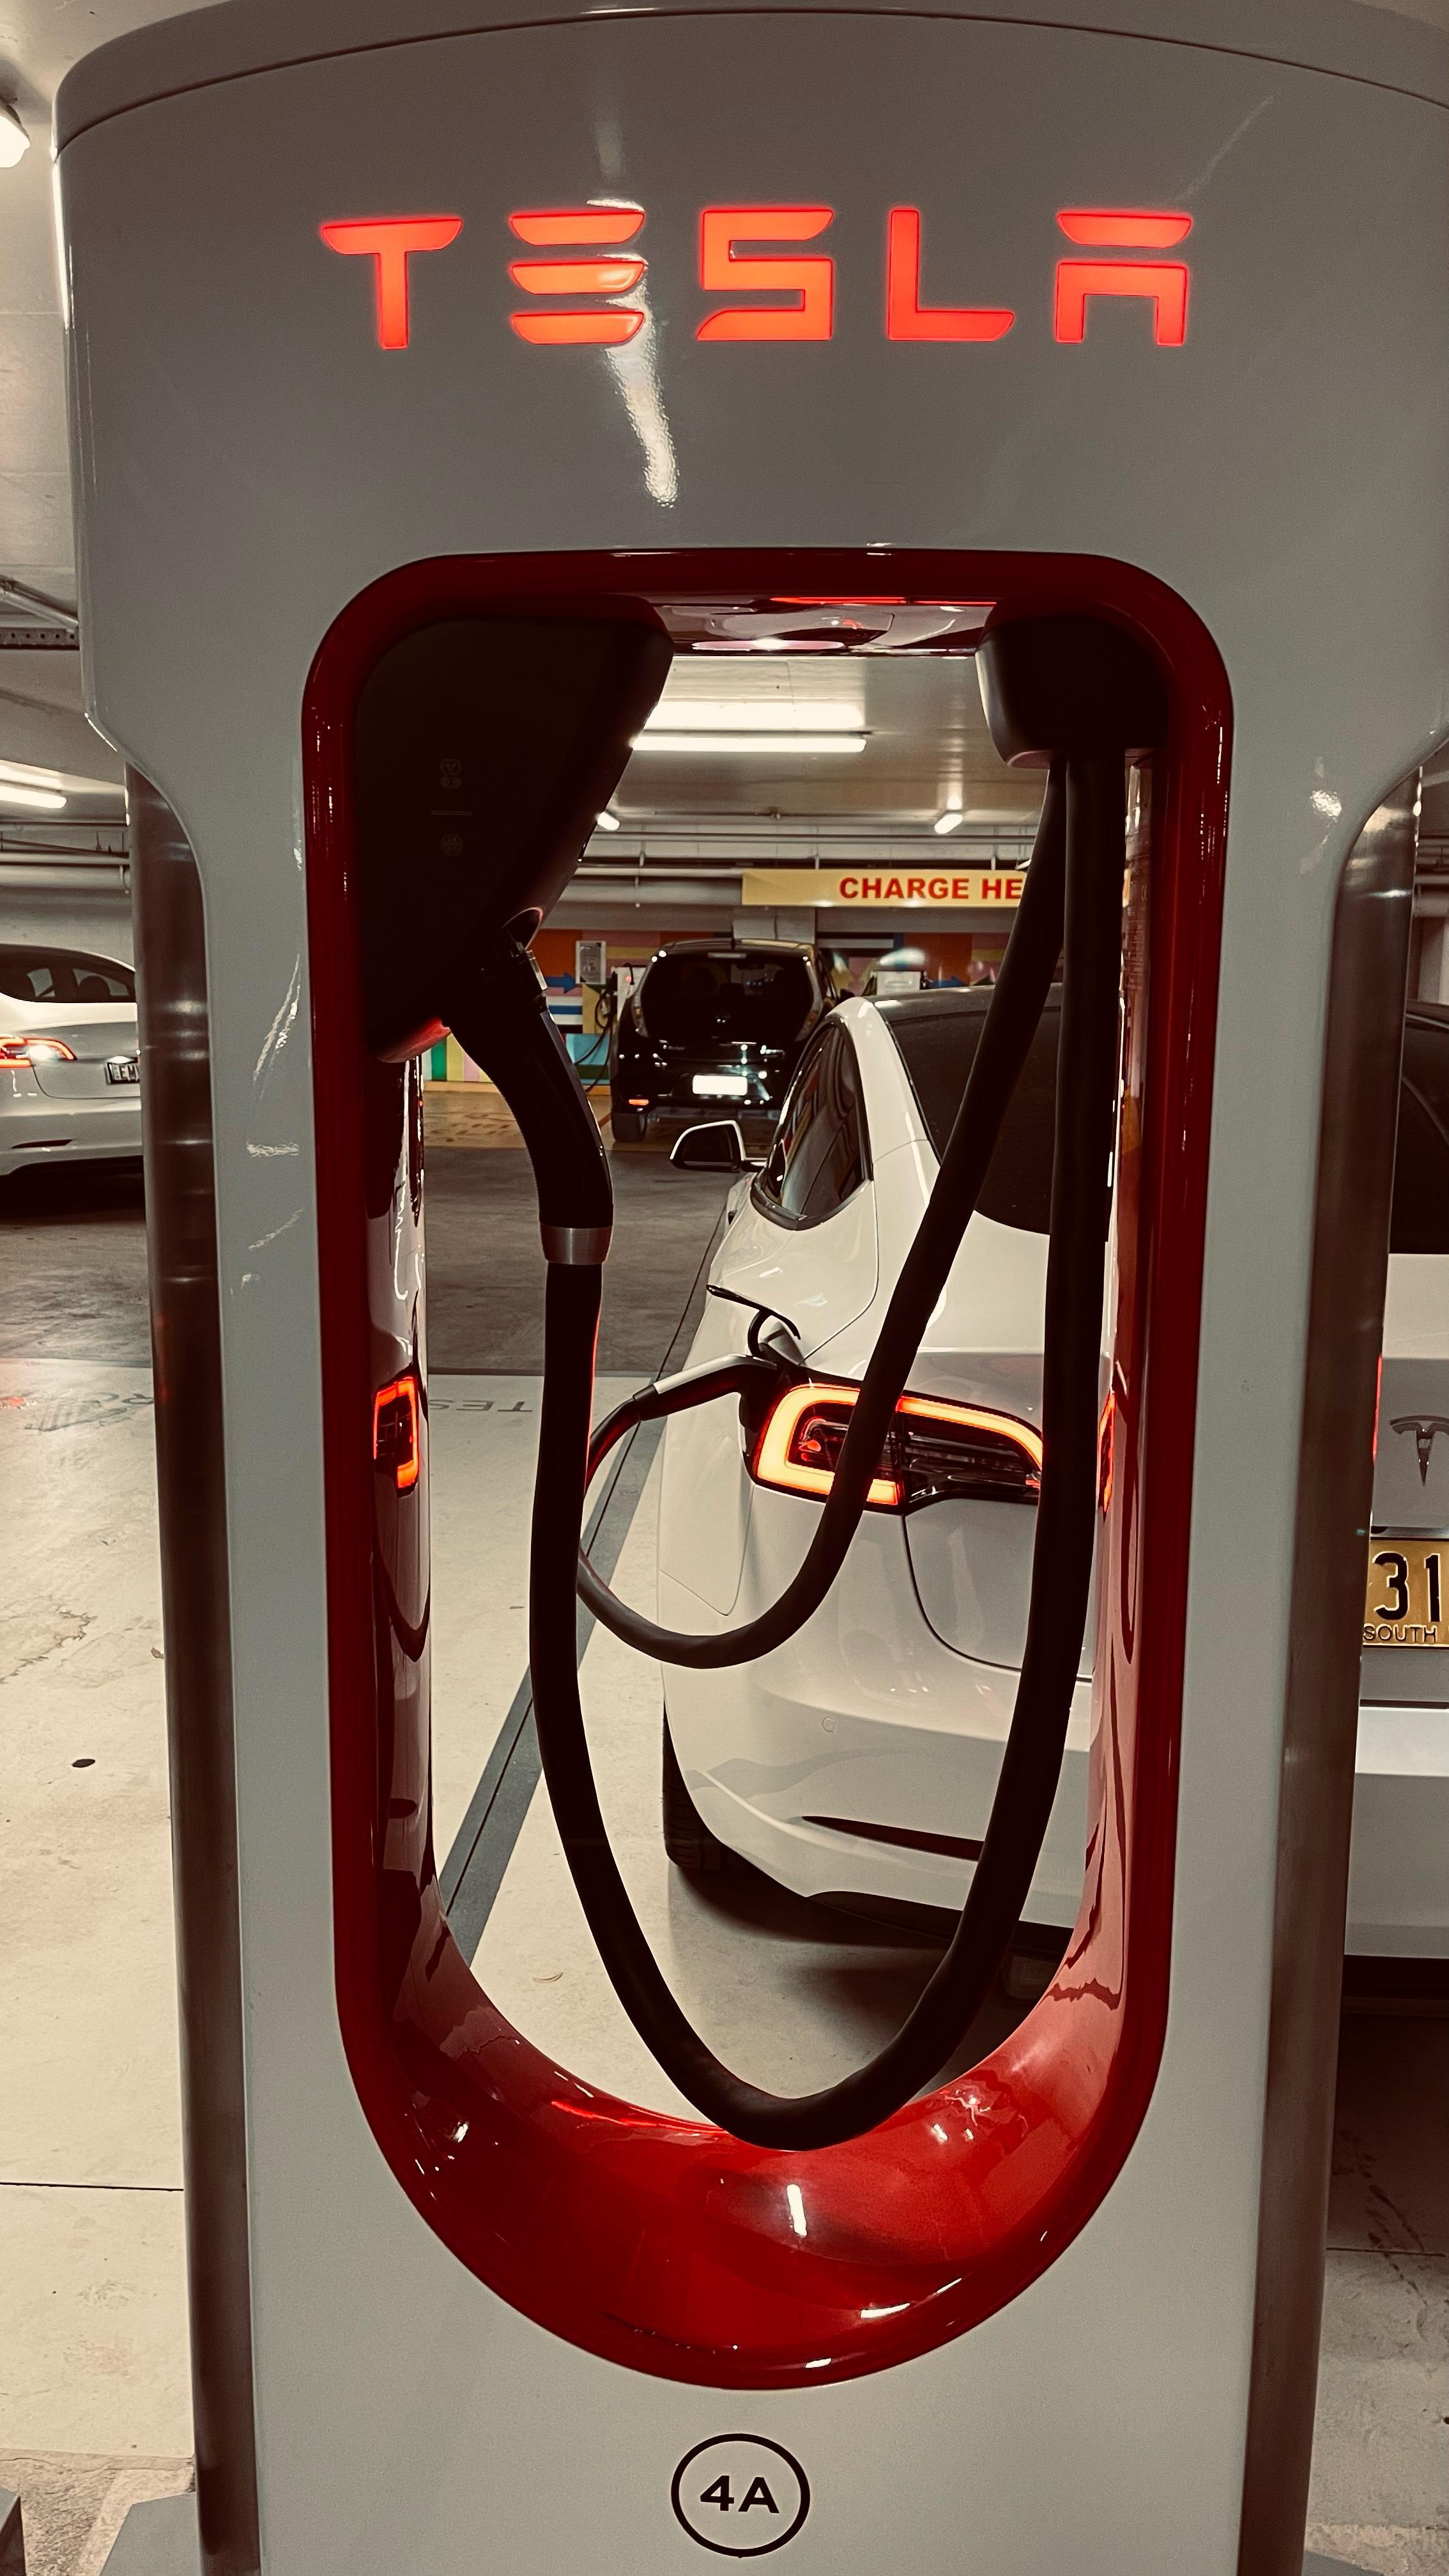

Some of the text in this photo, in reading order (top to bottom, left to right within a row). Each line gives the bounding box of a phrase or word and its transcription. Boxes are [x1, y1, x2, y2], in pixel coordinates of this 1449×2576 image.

[319, 208, 1192, 349] TESLA
[839, 878, 969, 899] CHARGE
[1372, 1551, 1442, 1623] 31
[1363, 1623, 1438, 1643] SOUTH
[700, 2475, 780, 2513] 4A
